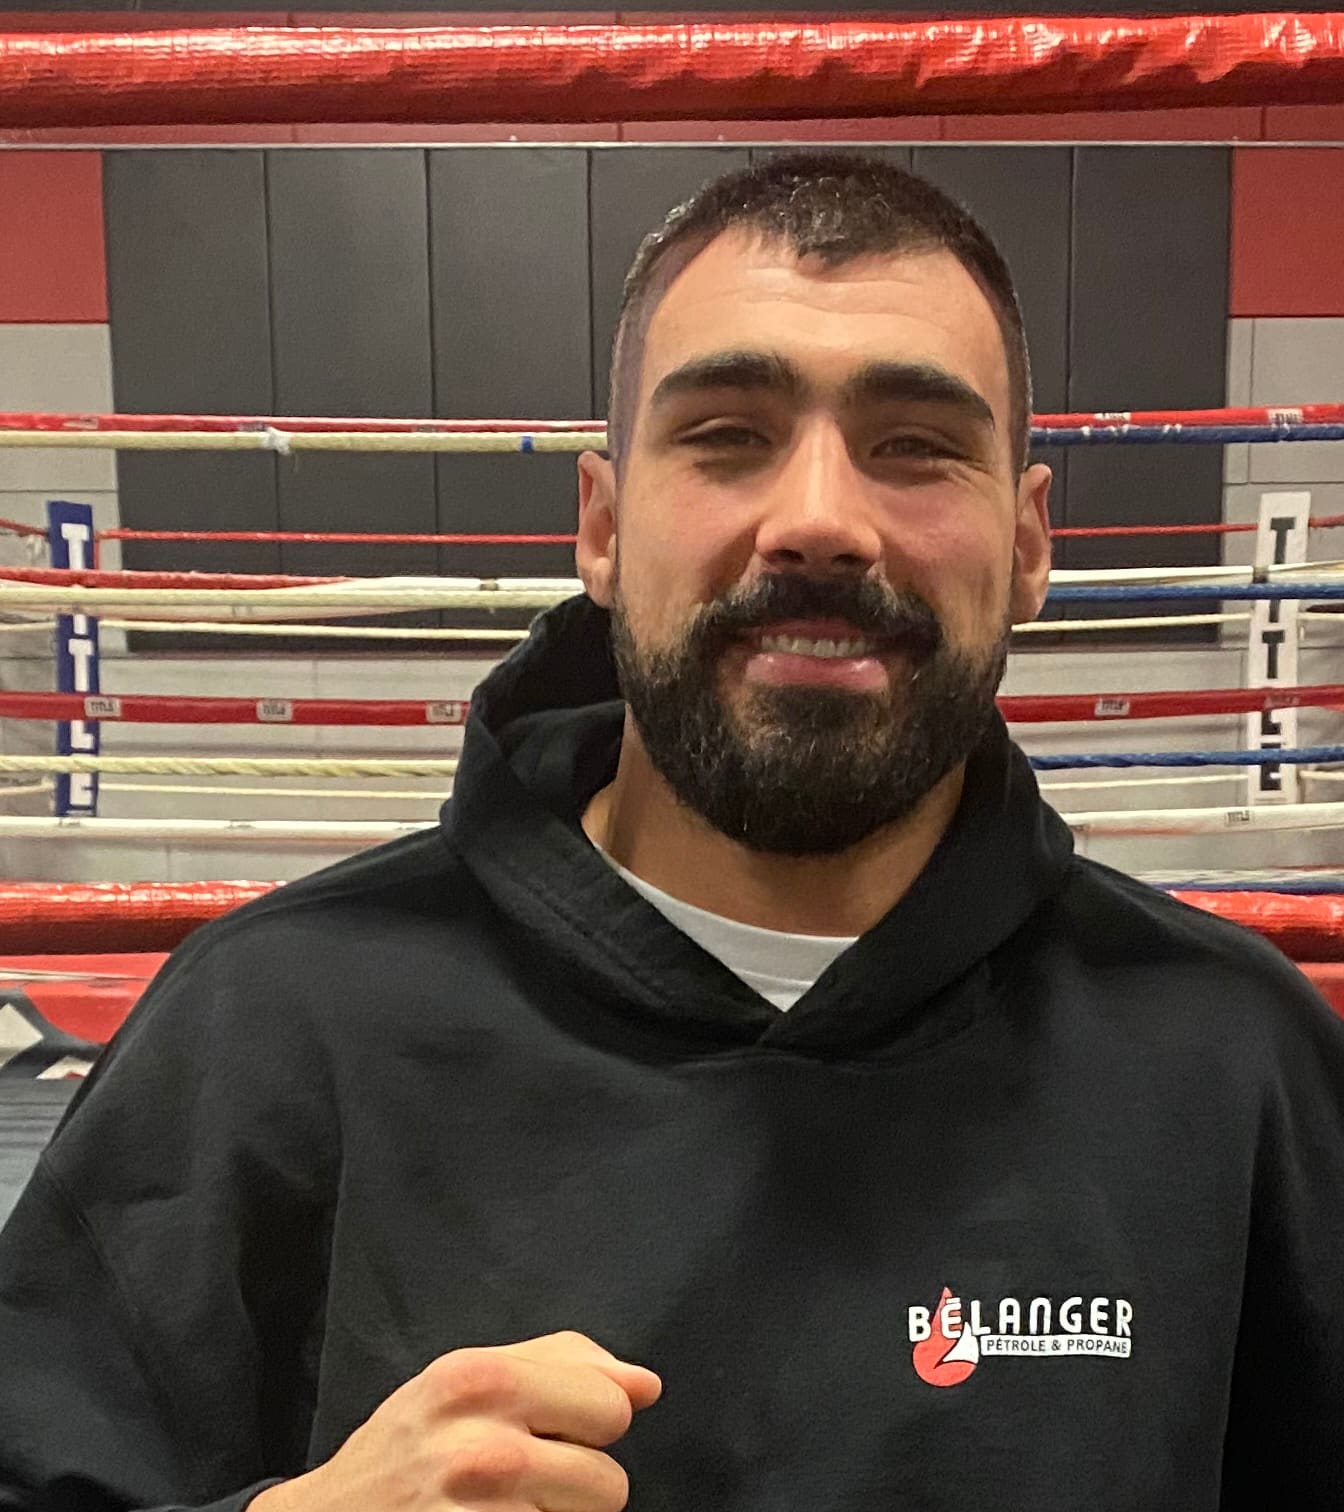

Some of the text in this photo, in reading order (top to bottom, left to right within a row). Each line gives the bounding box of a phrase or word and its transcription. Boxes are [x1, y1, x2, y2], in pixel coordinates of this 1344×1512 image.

[987, 1338, 1128, 1354] PÉTROLE & PROPANE
